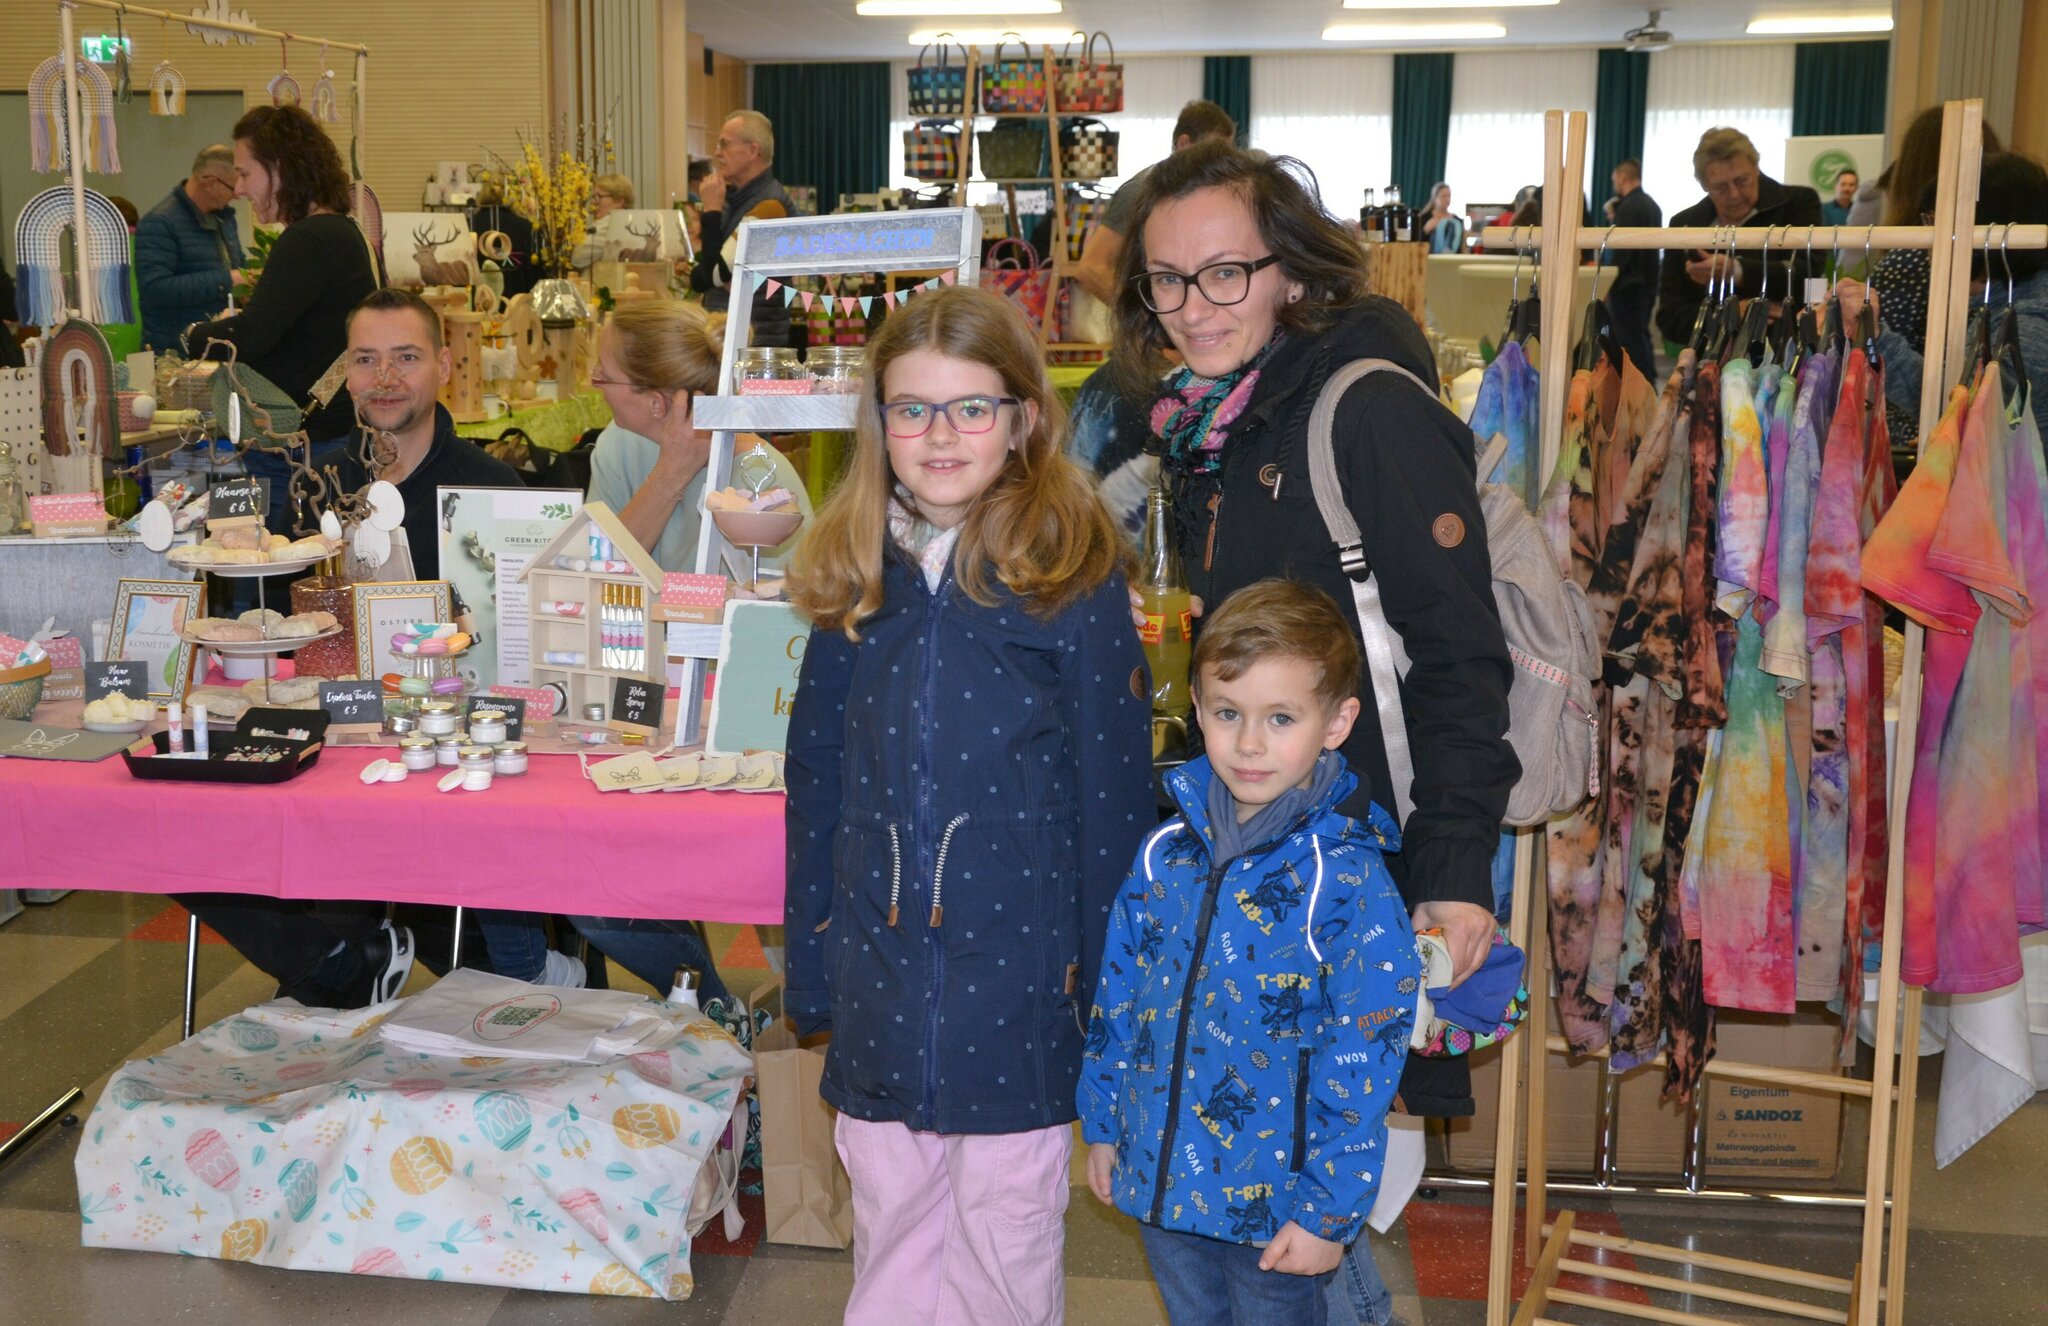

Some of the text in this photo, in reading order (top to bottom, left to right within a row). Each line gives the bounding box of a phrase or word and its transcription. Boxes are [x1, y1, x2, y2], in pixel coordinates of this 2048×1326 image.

[774, 227, 936, 257] BADESACHEN
[49, 526, 97, 536] Handmade
[504, 536, 532, 544] GREEN
[668, 581, 708, 593] Badebombe
[663, 608, 705, 619] Handmade
[128, 639, 172, 649] KOSMETIK
[108, 664, 129, 675] Haar
[98, 676, 131, 688] Balsam
[353, 689, 378, 701] Tonka
[629, 686, 647, 697] Relax
[475, 699, 517, 713] Rosencreme
[625, 696, 645, 710] Spray
[1327, 844, 1356, 858] ROAR
[1221, 931, 1238, 965] ROAR
[1357, 1006, 1397, 1031] ATTACK
[1206, 1020, 1234, 1047] ROAR
[1335, 1051, 1368, 1065] ROAR
[1730, 1086, 1790, 1099] Eigentum
[1734, 1109, 1803, 1121] SANDOZ
[1344, 1138, 1376, 1153] ROAR
[1716, 1143, 1796, 1153] Mehrweggebinde
[1184, 1143, 1205, 1176] ROAR
[1762, 1158, 1778, 1167] und
